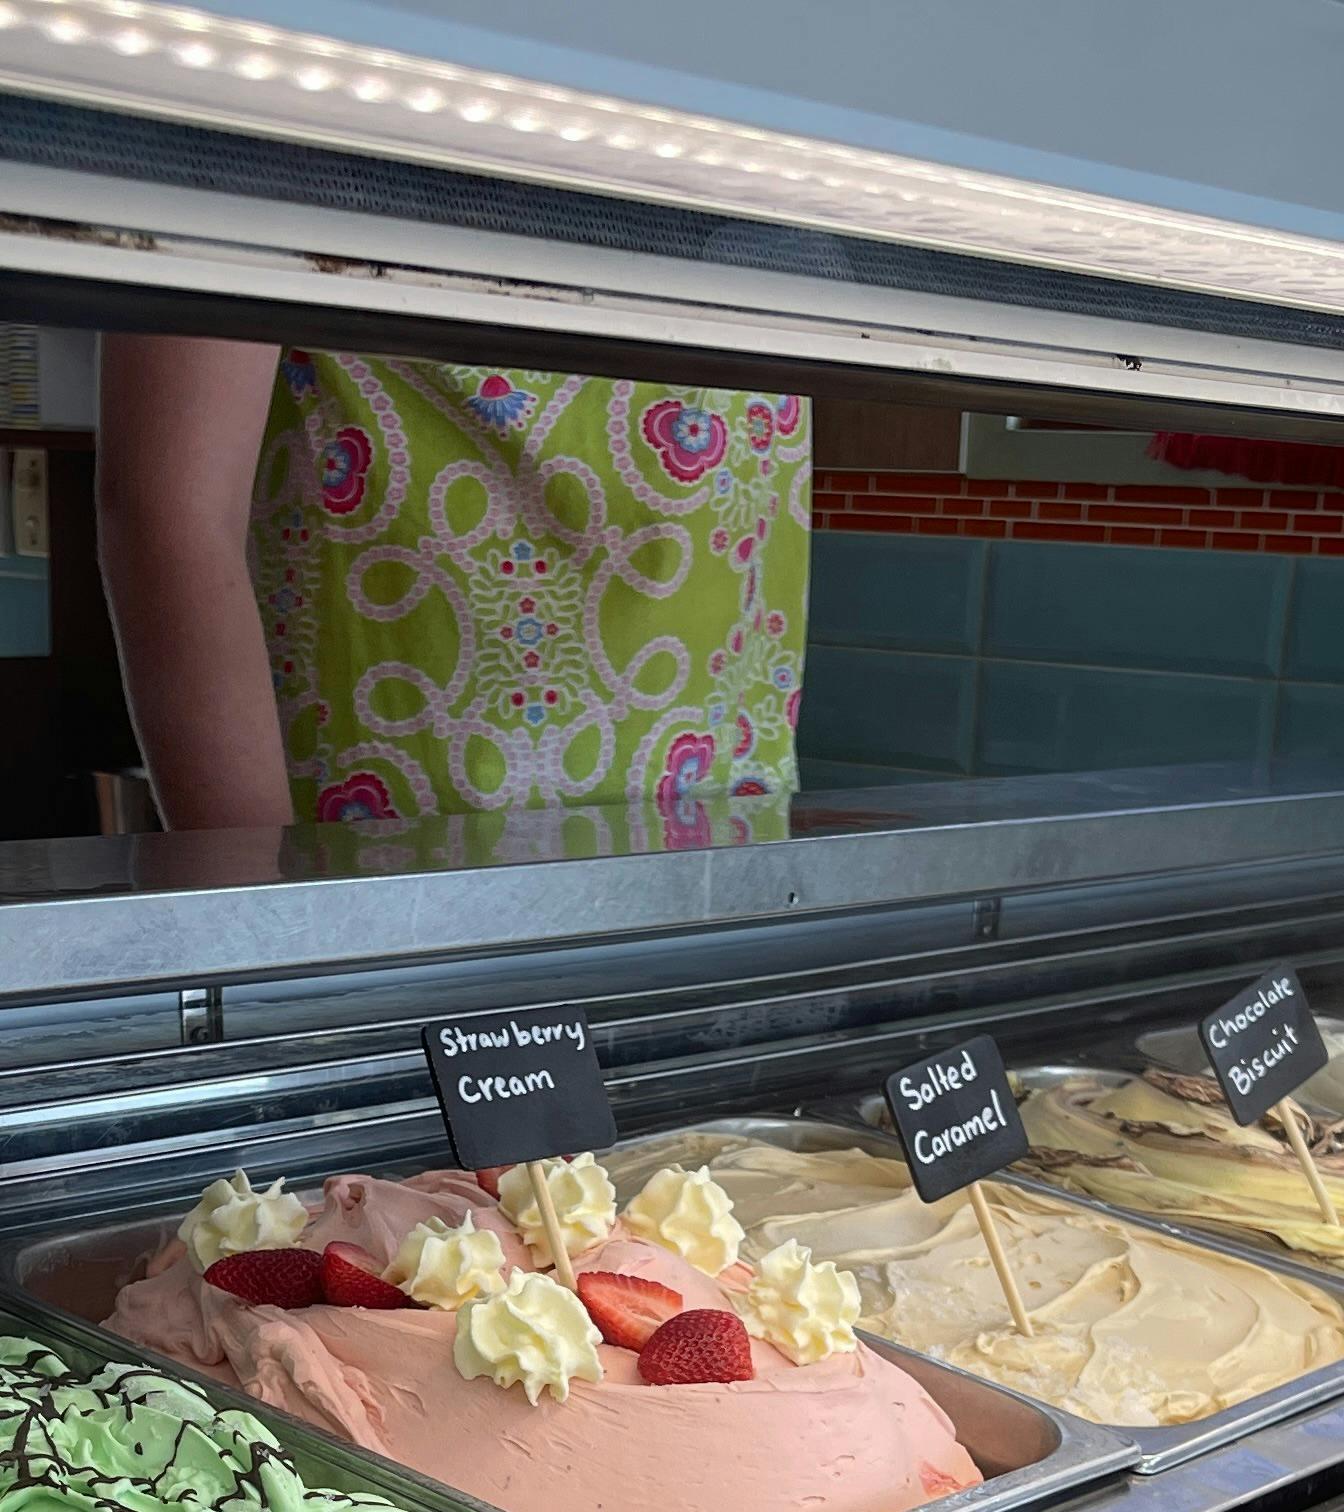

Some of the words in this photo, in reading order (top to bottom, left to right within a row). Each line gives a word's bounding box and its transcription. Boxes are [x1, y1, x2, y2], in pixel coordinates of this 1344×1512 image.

[440, 1021, 585, 1057] Strawberry
[1209, 978, 1294, 1048] Chocolate
[458, 1070, 555, 1103] Cream
[900, 1050, 978, 1110] Salted
[1228, 1024, 1299, 1095] Biscuit
[915, 1089, 1007, 1164] Caramel
